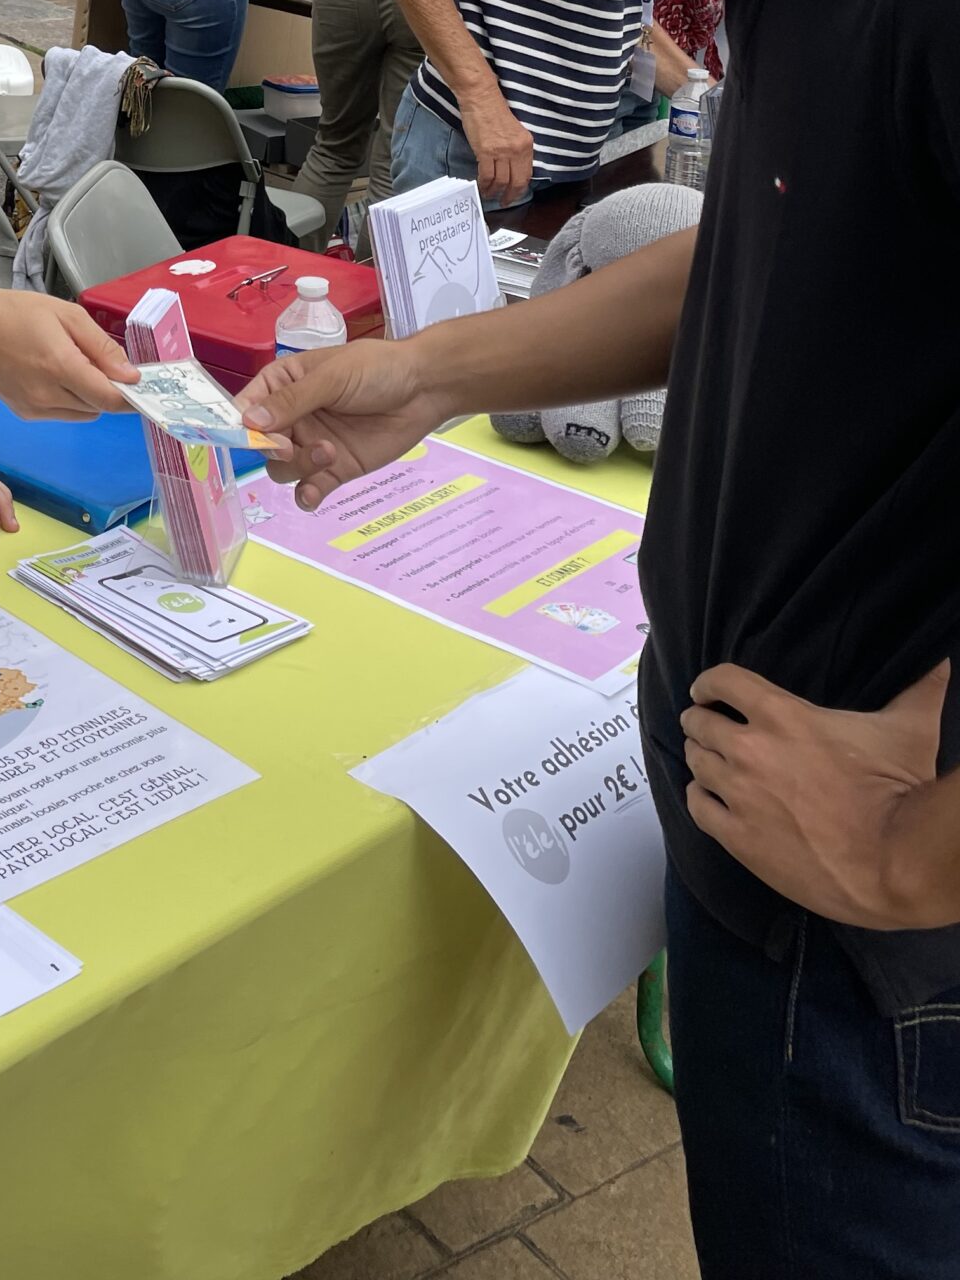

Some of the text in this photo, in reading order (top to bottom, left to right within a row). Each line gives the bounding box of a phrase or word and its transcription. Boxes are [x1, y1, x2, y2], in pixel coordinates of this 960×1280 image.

[411, 199, 470, 234] Annuaire des
[419, 220, 471, 253] prestataires
[338, 483, 378, 506] monnaie
[375, 471, 406, 489] locale
[339, 497, 385, 521] citoyenne
[15, 746, 40, 760] DE
[40, 736, 59, 750] 80
[58, 706, 132, 741] MONNAIES
[39, 751, 63, 765] ET
[61, 713, 148, 753] CITOYENNES
[0, 786, 30, 805] ayant
[30, 775, 55, 791] opté
[53, 763, 80, 782] pour
[79, 755, 102, 768] une
[100, 735, 146, 758] économie
[146, 725, 168, 739] plus
[33, 799, 69, 819] locales
[69, 781, 104, 803] proche
[103, 773, 119, 784] de
[117, 764, 142, 779] chez
[141, 753, 166, 769] vous
[467, 770, 540, 813] Votre
[541, 712, 630, 776] adhésion
[98, 789, 141, 813] C'EST
[559, 792, 606, 841] pour
[0, 848, 54, 880] PAYER
[105, 802, 146, 827] C'EST
[144, 777, 199, 807] L'IDÉAL
